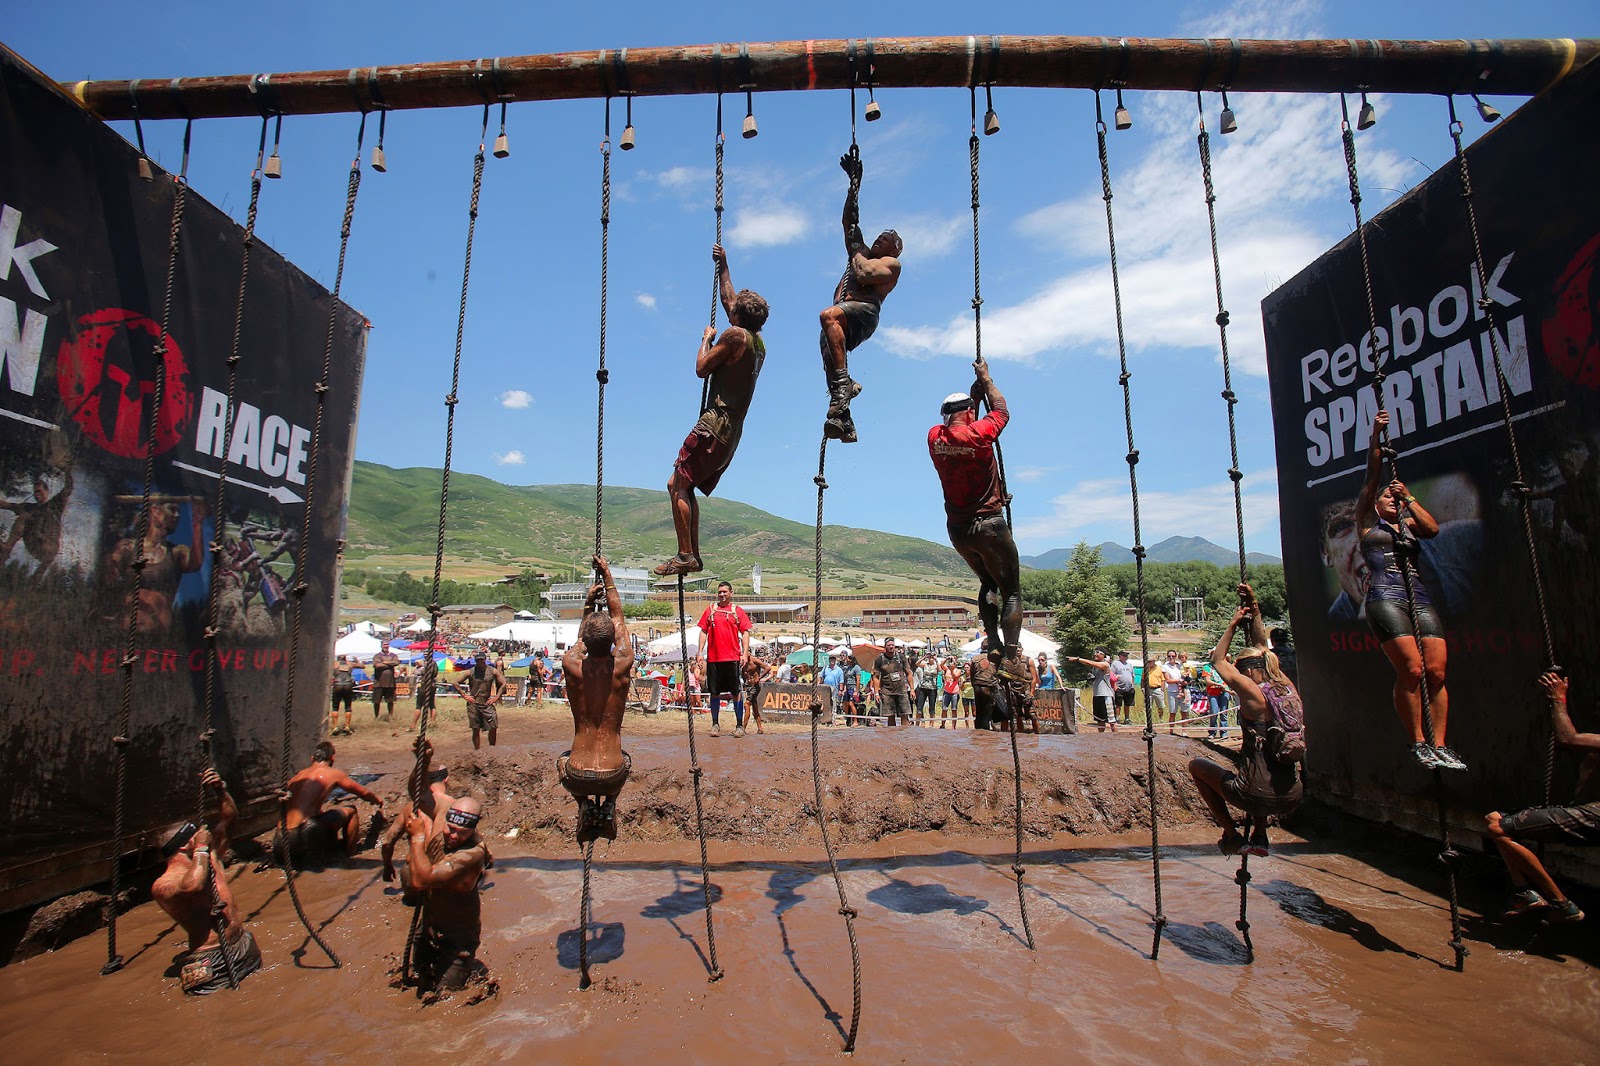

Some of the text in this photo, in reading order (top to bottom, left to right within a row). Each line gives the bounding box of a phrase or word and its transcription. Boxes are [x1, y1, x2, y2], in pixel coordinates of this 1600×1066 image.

[1301, 251, 1521, 403] Reebok
[1304, 314, 1532, 466] SPARTAN
[195, 386, 311, 485] RACE
[1329, 631, 1380, 652] SIGN
[72, 649, 177, 675] NEER
[188, 649, 245, 671] GVE
[252, 649, 289, 670] UP!
[763, 692, 790, 709] AIR
[791, 693, 823, 701] NATIOAL
[1035, 708, 1063, 720] UARD
